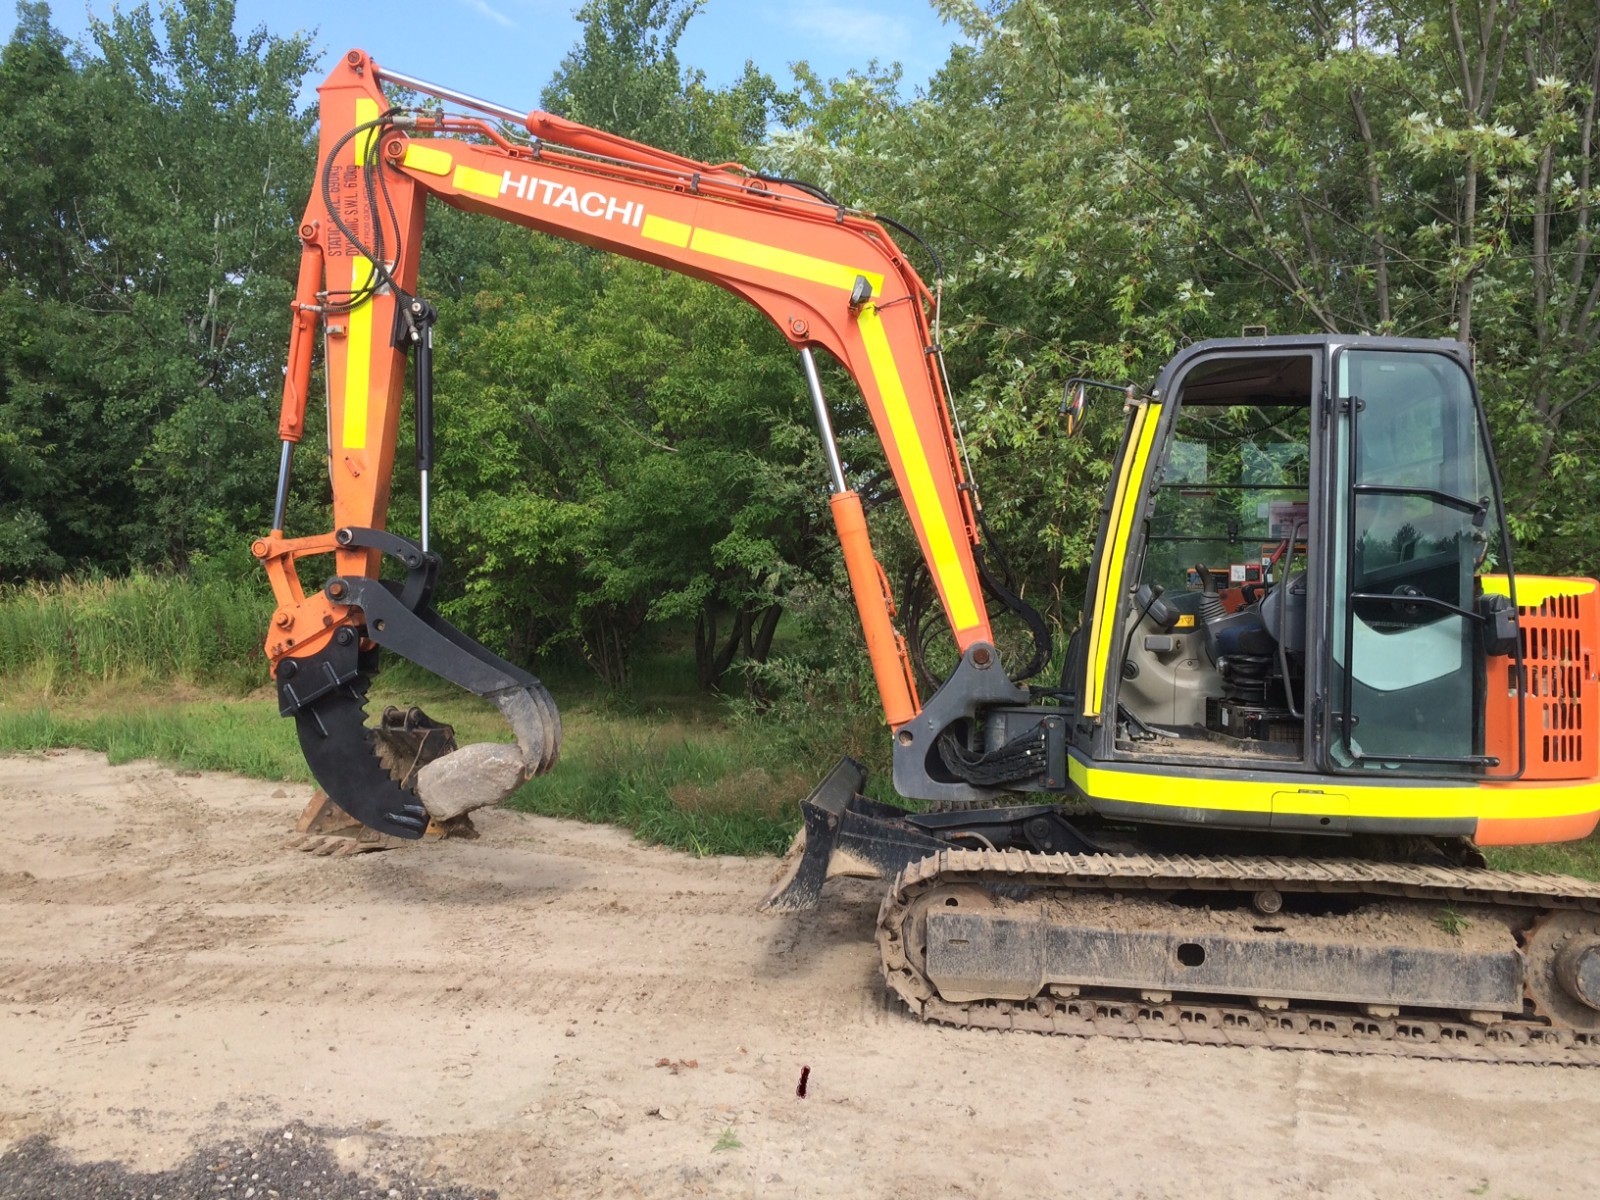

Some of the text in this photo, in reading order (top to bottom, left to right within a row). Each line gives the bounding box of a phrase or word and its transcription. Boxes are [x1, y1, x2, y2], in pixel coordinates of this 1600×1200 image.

[344, 165, 360, 188] 610kg
[344, 191, 358, 215] S.W.L.
[500, 170, 644, 228] HITACHI
[328, 227, 342, 256] STATIC
